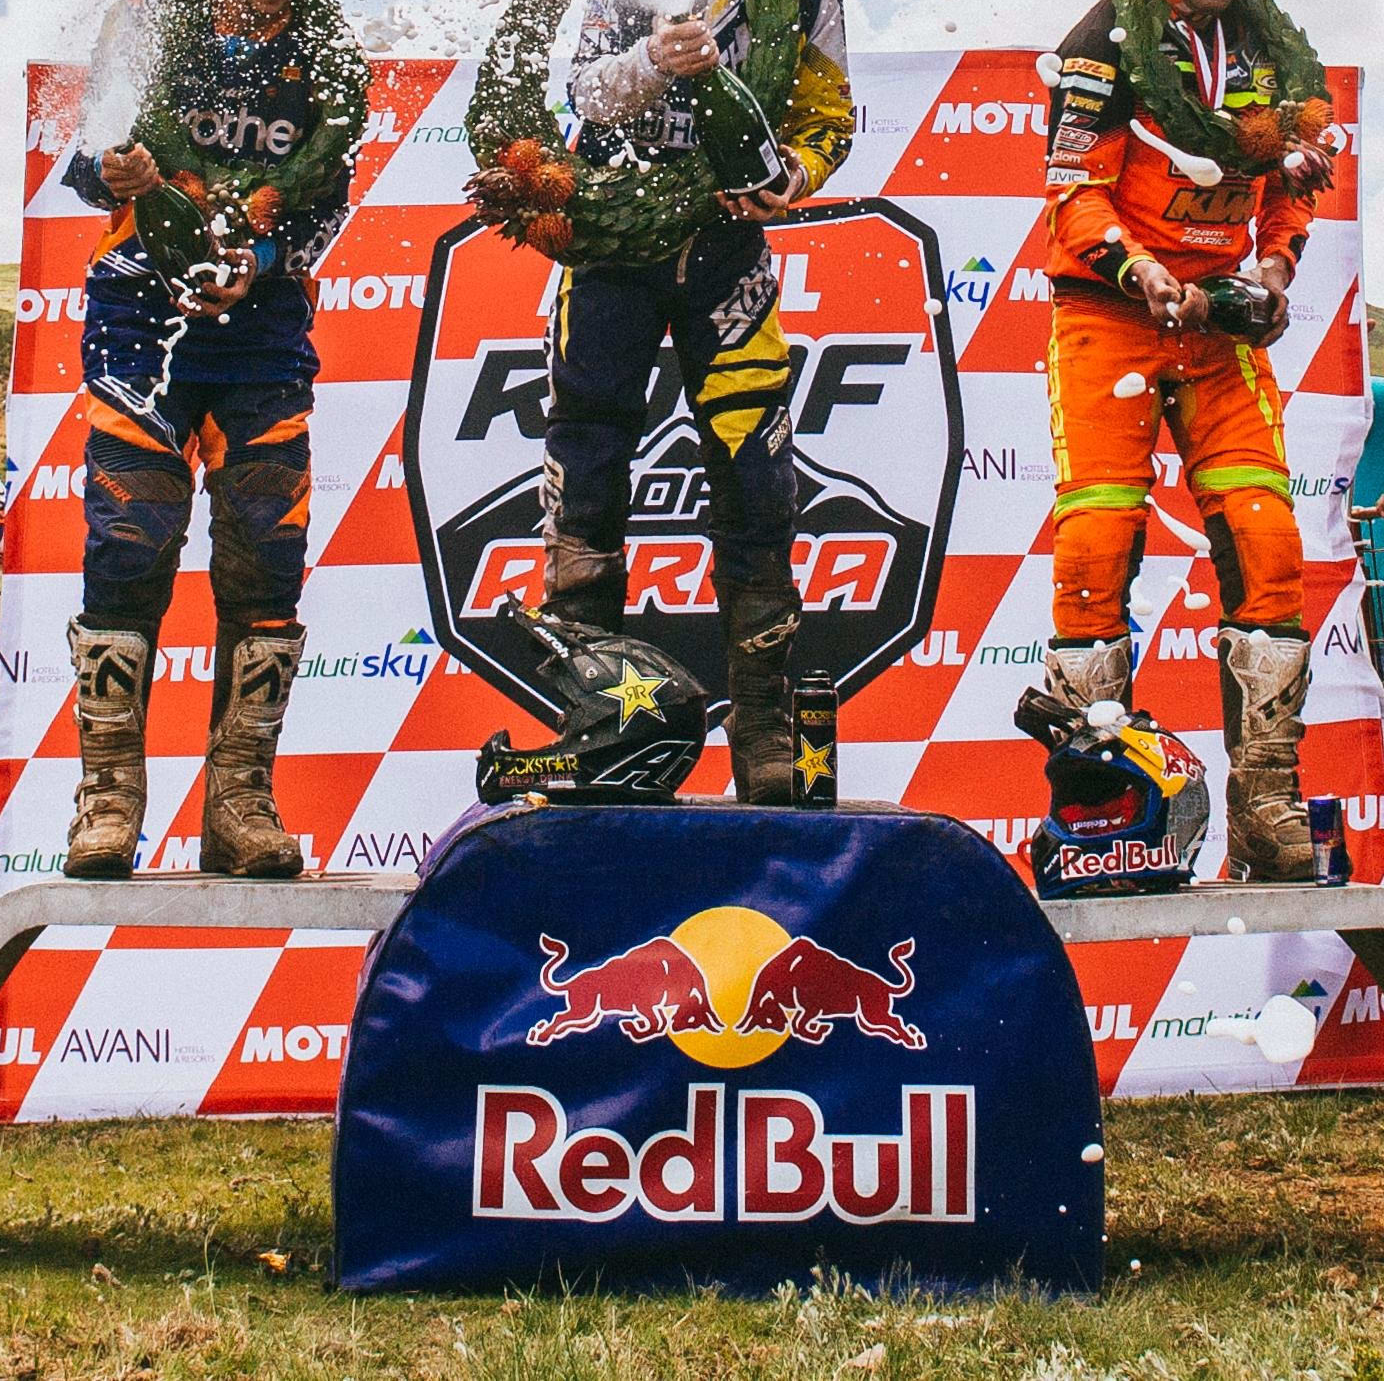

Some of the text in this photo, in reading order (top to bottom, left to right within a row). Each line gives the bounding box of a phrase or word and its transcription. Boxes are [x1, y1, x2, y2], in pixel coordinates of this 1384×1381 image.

[184, 106, 304, 156] rothe
[931, 102, 1049, 137] MOTU
[16, 287, 88, 323] OTU
[316, 274, 427, 311] MOTU
[962, 447, 1016, 481] ANI
[297, 654, 358, 678] aluti
[1060, 839, 1124, 880] Red
[1125, 833, 1179, 873] Bull
[60, 1027, 170, 1064] AVANI
[472, 1082, 976, 1224] Red Bull
